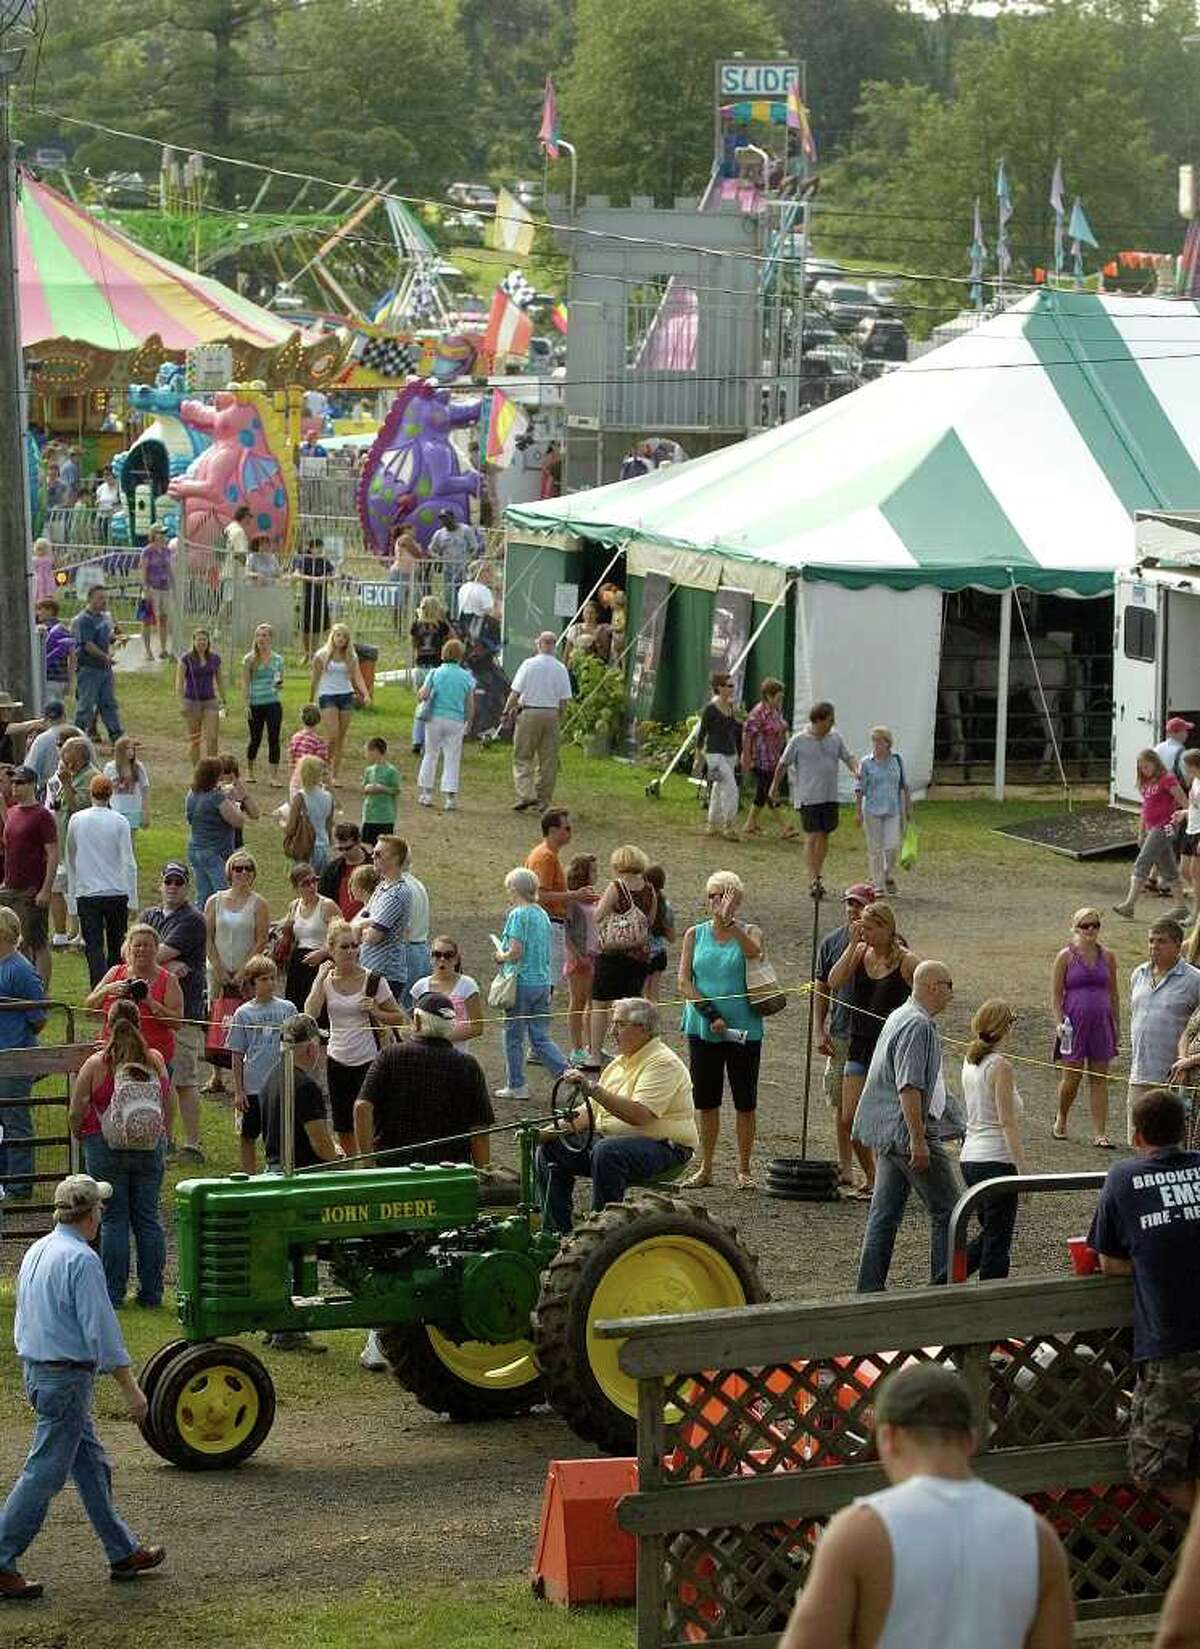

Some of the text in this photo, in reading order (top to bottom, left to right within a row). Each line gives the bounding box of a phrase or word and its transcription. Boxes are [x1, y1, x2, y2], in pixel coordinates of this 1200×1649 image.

[363, 585, 398, 606] EXIT
[1132, 1167, 1200, 1189] BROOKFI
[1160, 1182, 1200, 1207] EMS
[321, 1200, 438, 1224] JOHN DEERE
[1140, 1210, 1171, 1229] FIRE
